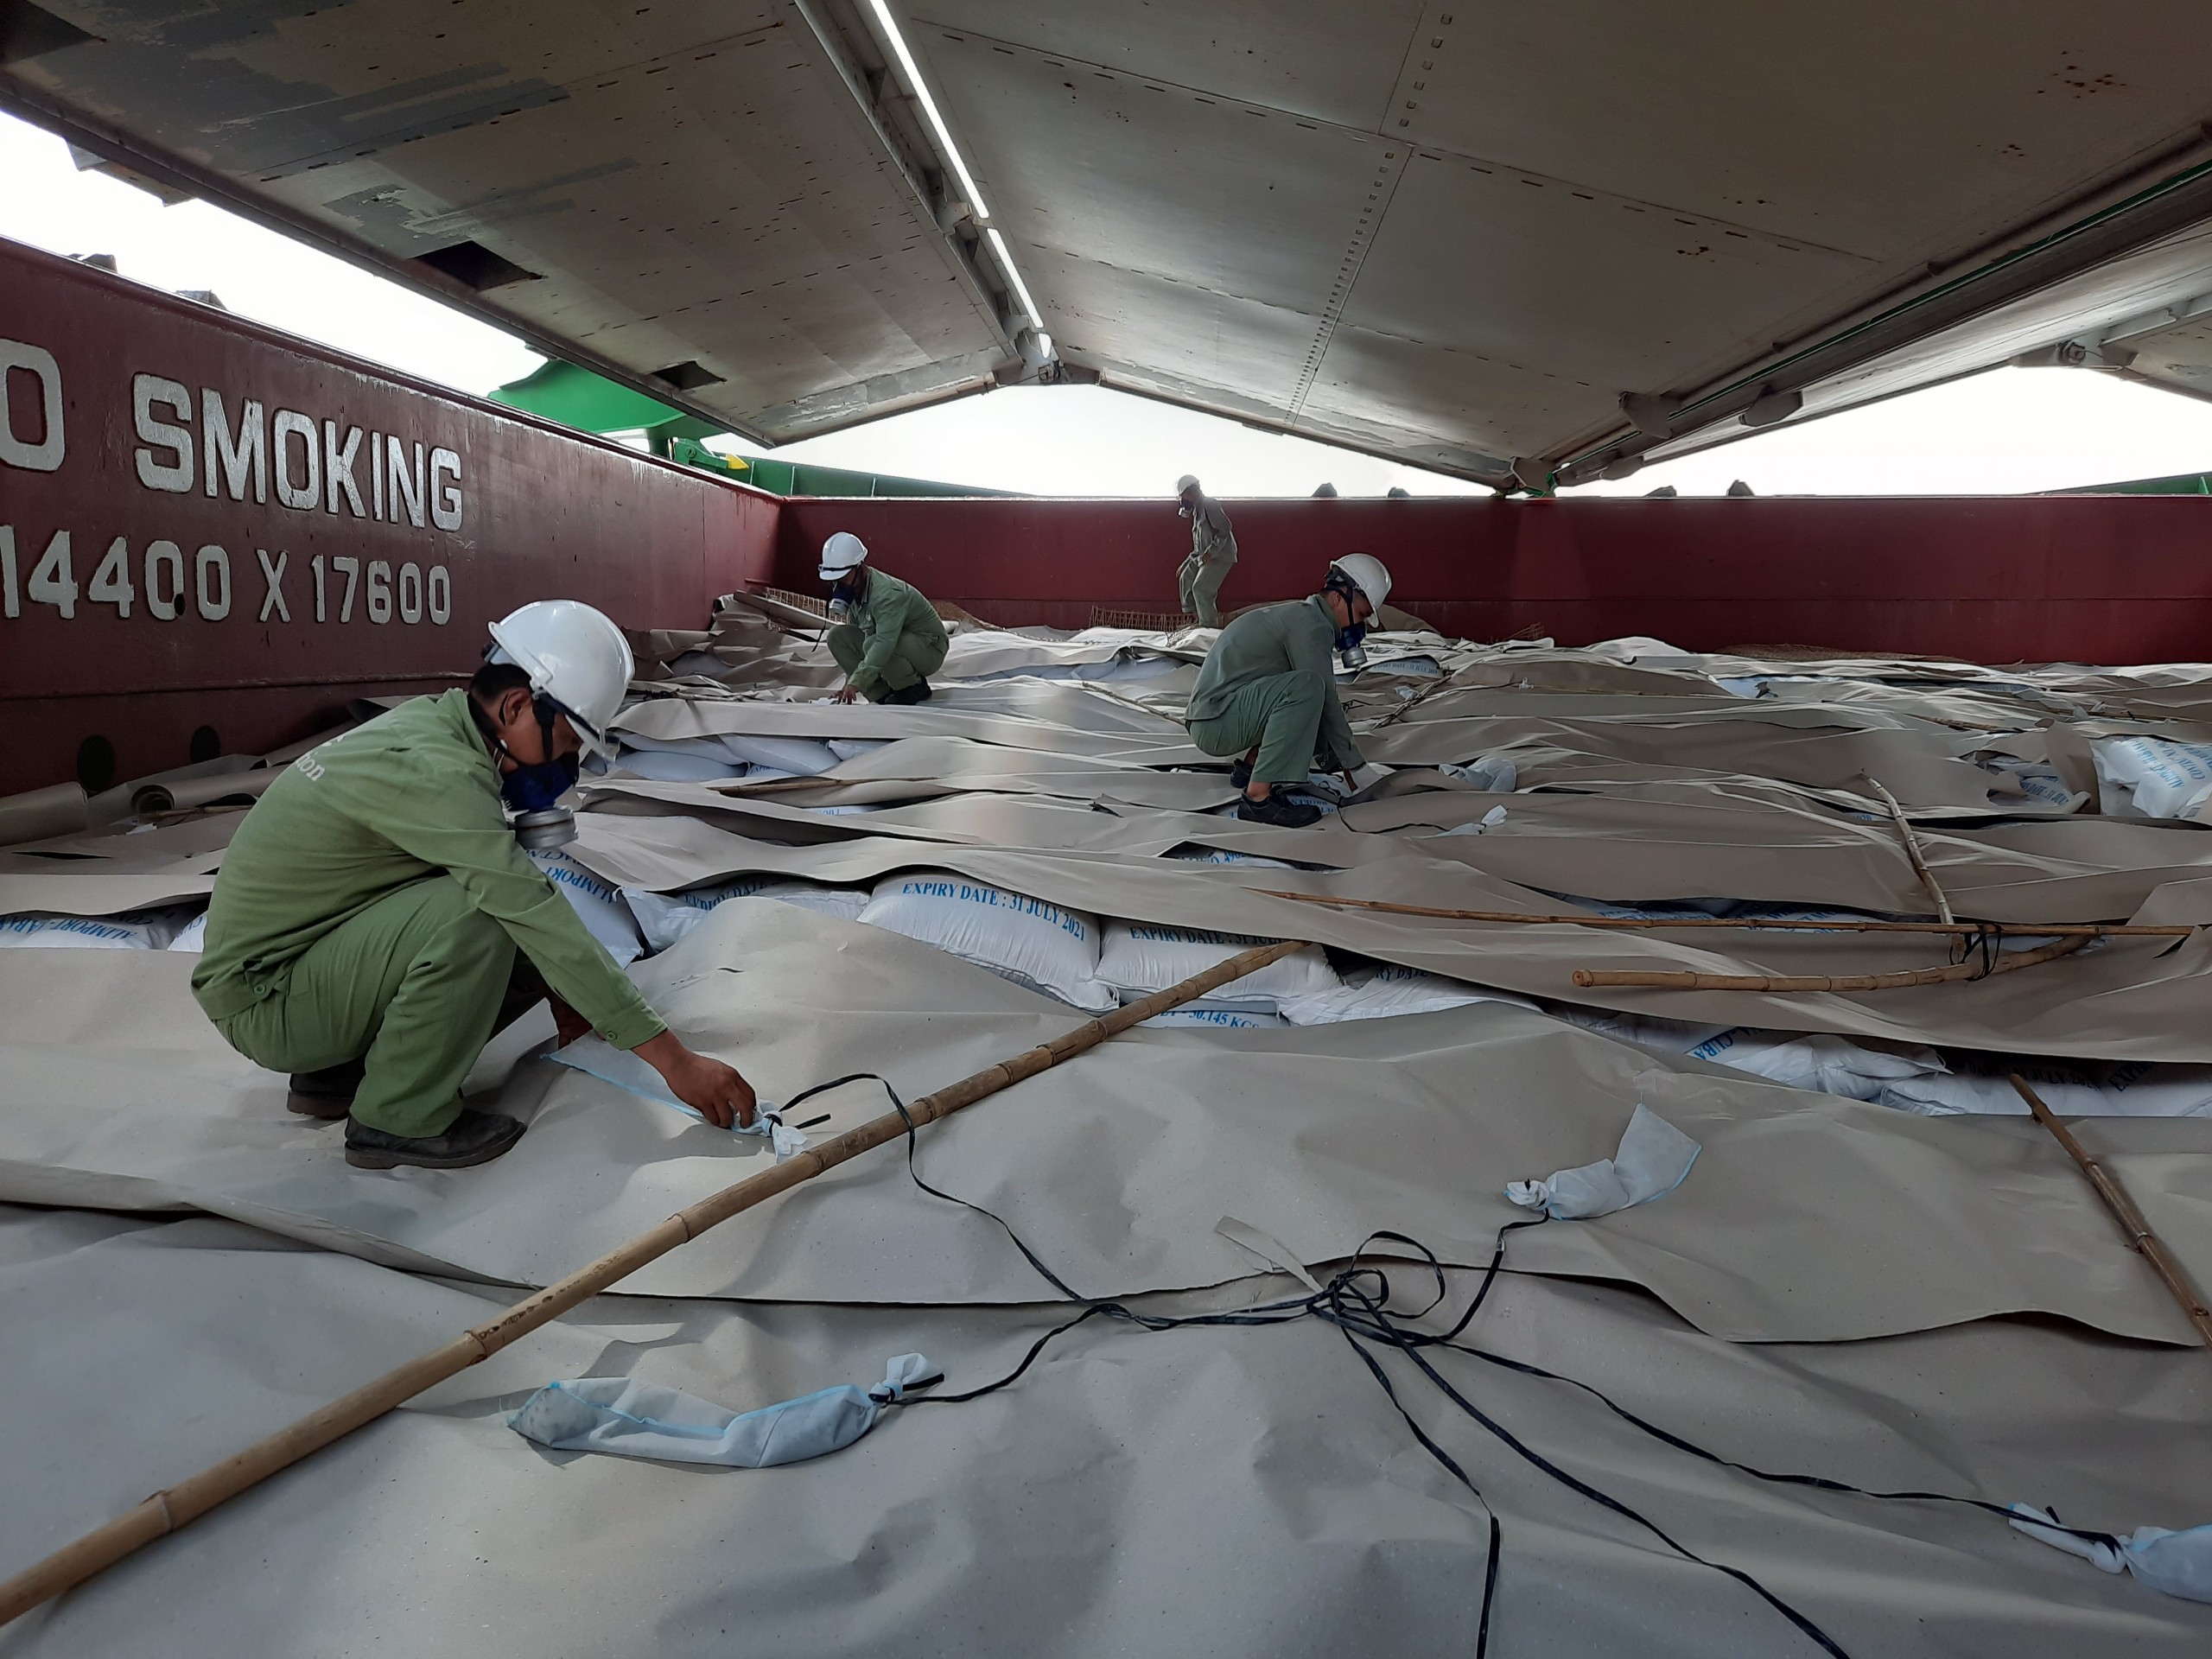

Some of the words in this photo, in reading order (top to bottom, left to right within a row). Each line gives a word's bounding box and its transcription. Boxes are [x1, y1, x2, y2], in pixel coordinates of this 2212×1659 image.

[132, 372, 463, 532] SMOKING
[257, 548, 291, 624] X
[310, 553, 451, 626] 17600
[902, 882, 958, 898] EXPIRY
[960, 886, 1000, 907] DATE
[1009, 893, 1025, 912] 31
[1026, 898, 1062, 925] JULY
[1062, 912, 1086, 943] 2021
[1129, 926, 1185, 944] EXPIRY
